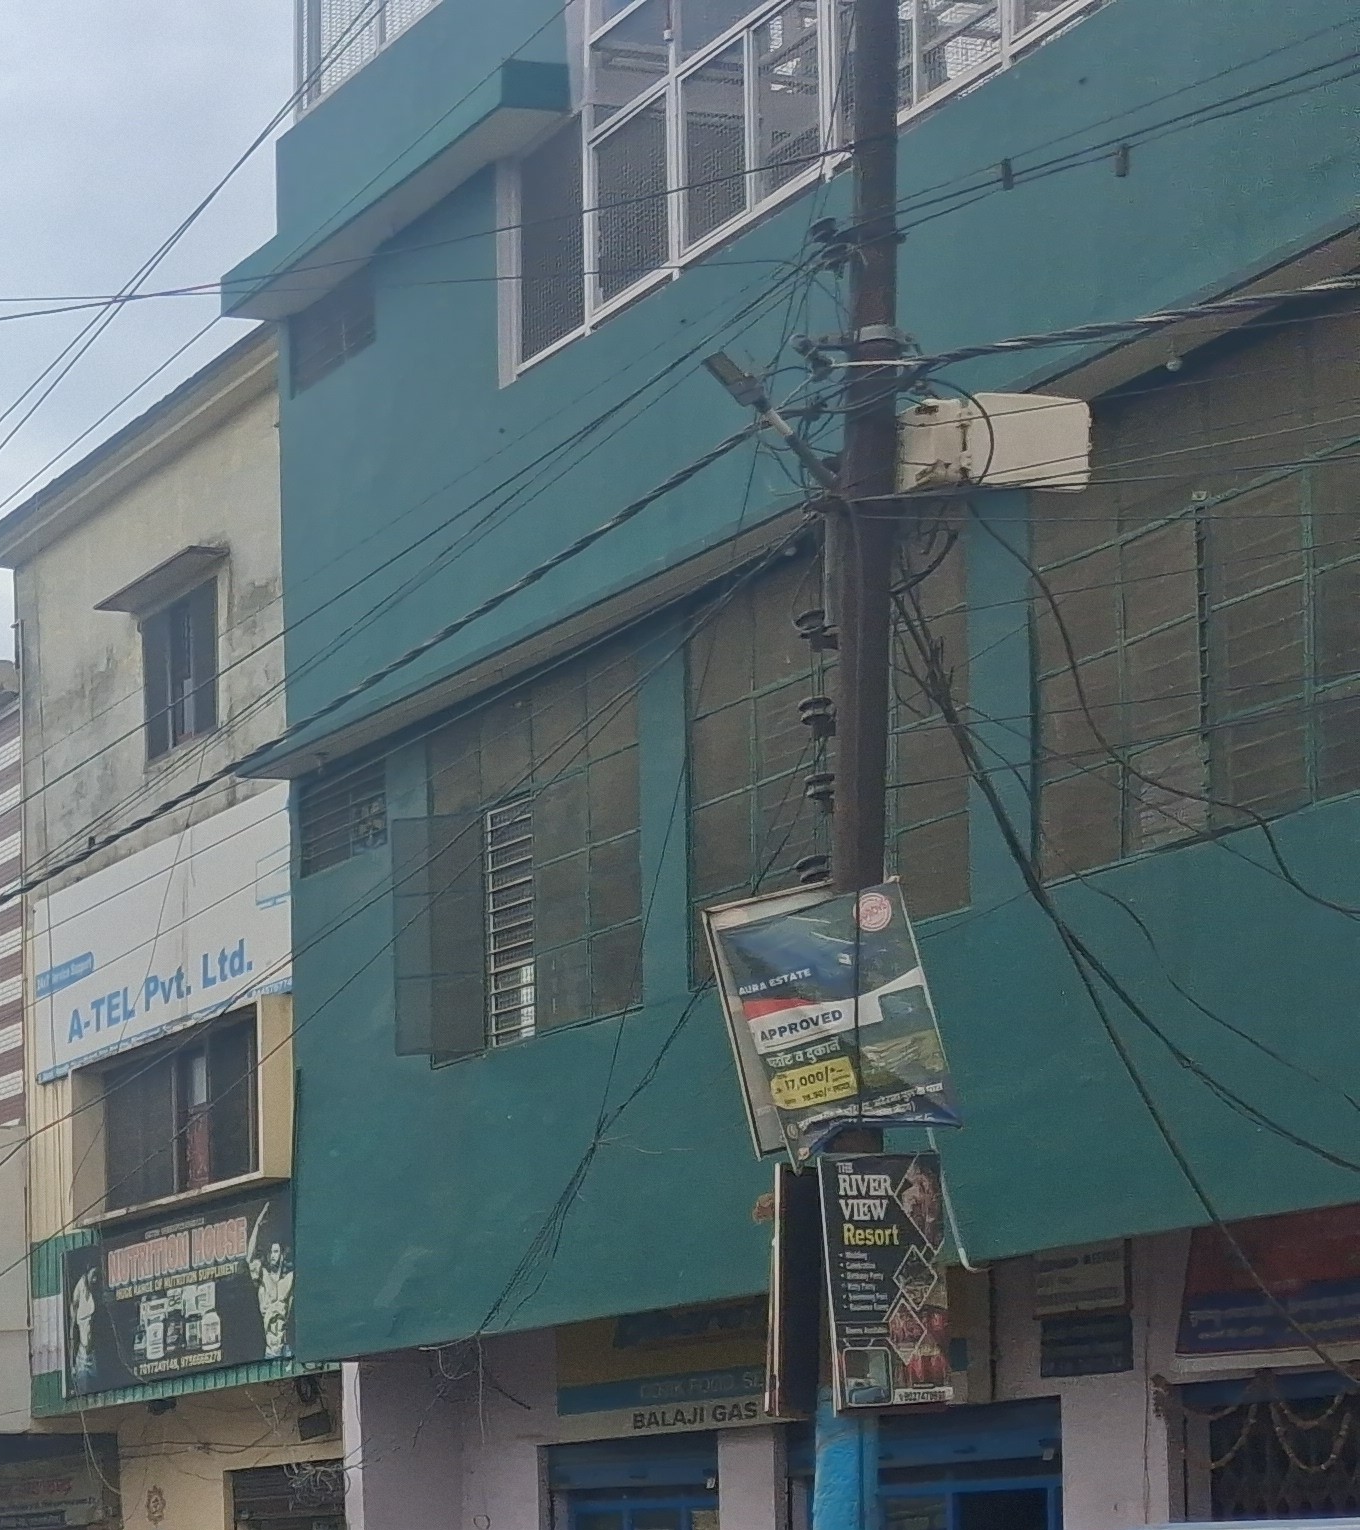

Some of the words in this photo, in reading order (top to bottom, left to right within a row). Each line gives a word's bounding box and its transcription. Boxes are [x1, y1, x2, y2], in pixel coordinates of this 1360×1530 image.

[68, 986, 135, 1043] A-TEL
[145, 965, 191, 1012] Pvt.
[202, 938, 253, 988] Ltd.
[739, 982, 766, 996] AURA
[769, 968, 812, 986] ESTATE
[760, 1009, 843, 1042] APPROVED
[838, 1174, 896, 1197] RIVER
[839, 1199, 888, 1221] VIEW
[843, 1223, 899, 1246] Resort
[108, 1231, 189, 1289] NUTRITION
[191, 1217, 247, 1270] HOUSE
[633, 1406, 705, 1430] BALAJI
[711, 1401, 758, 1423] GAS
